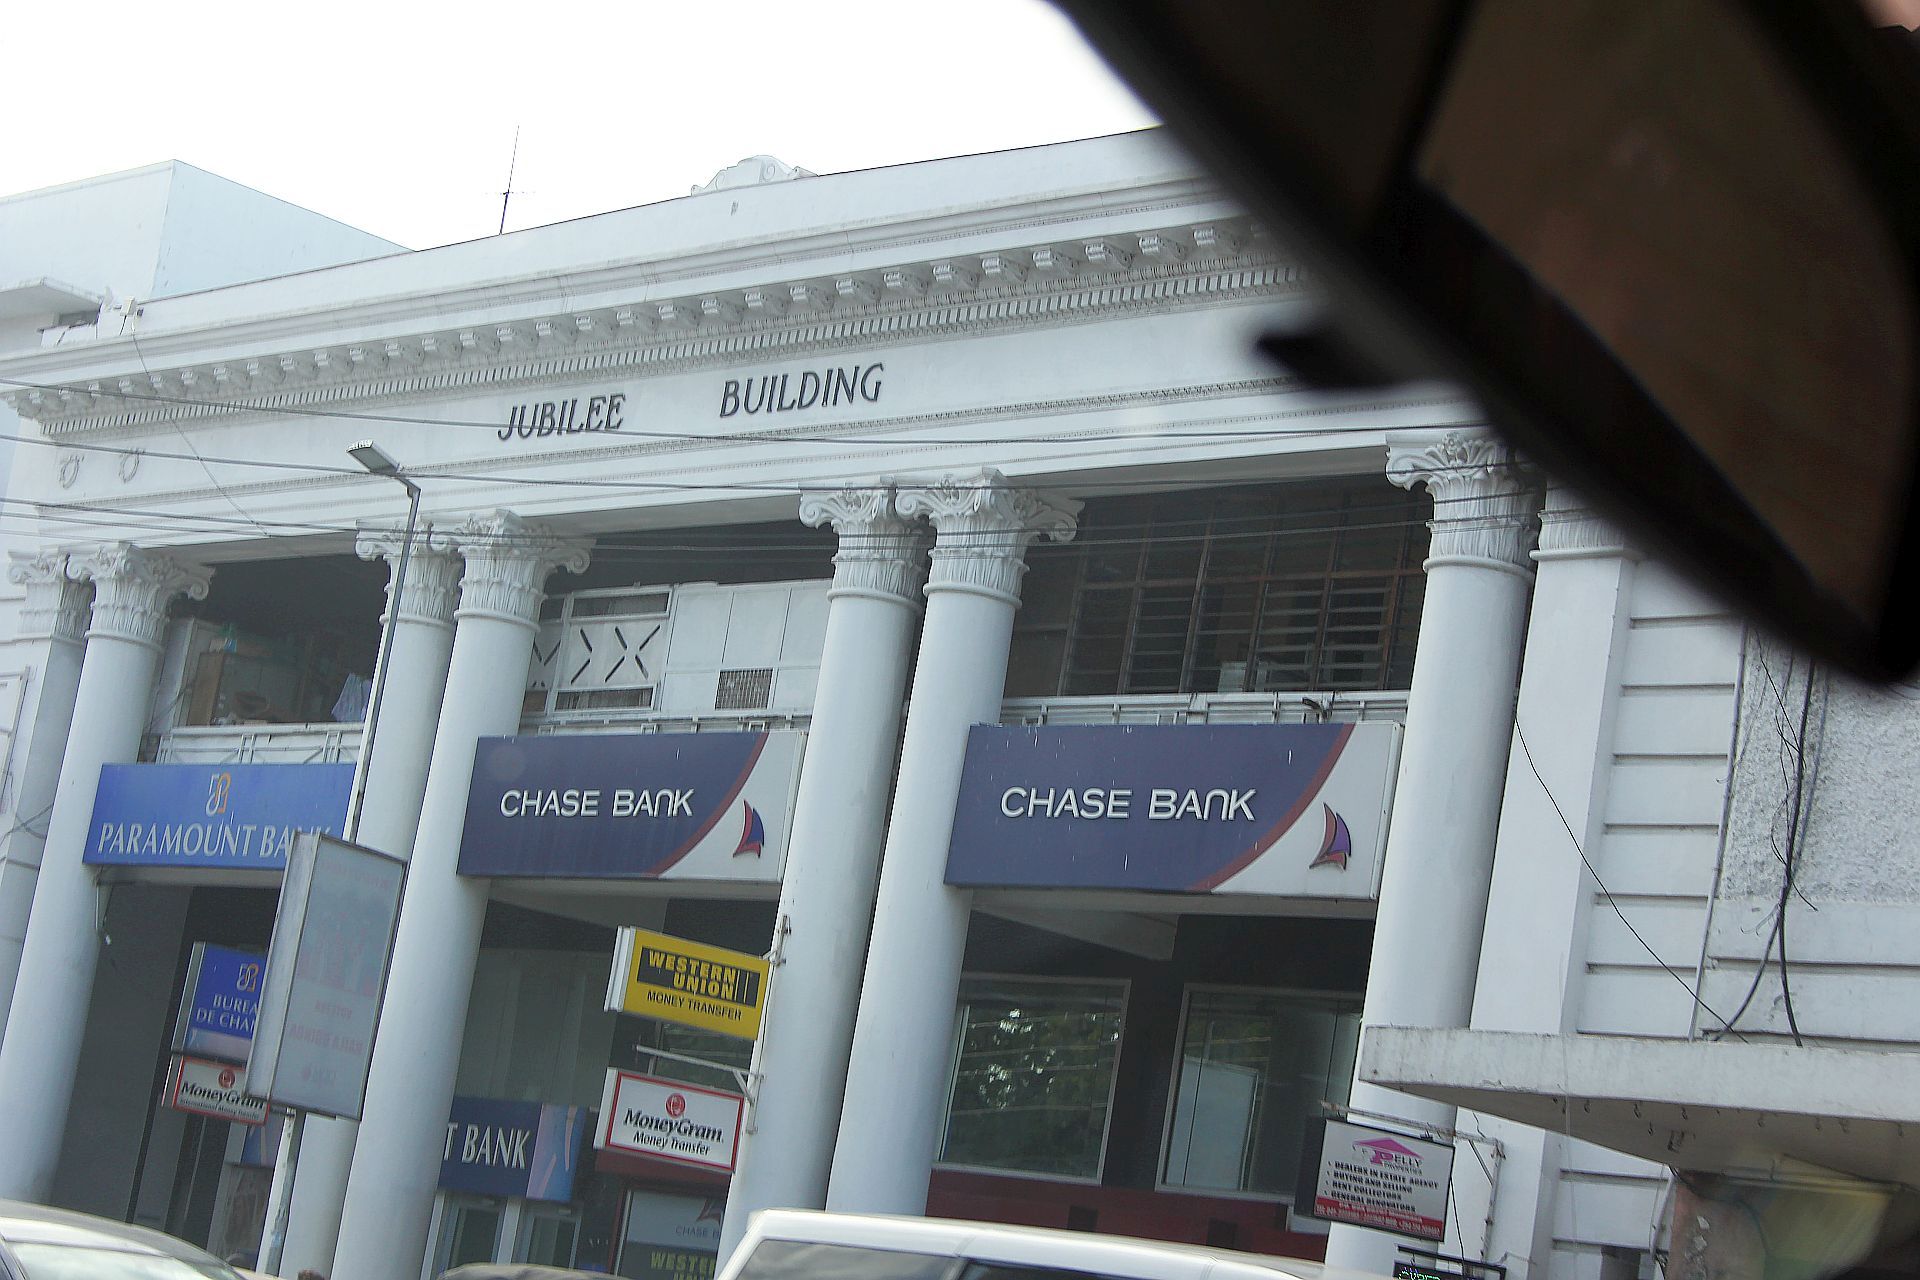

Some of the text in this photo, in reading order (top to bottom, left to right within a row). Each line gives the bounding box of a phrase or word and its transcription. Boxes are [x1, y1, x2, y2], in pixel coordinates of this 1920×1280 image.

[498, 362, 884, 440] JUBILEE BUILDING
[500, 788, 694, 817] CHASE BANK
[1001, 786, 1256, 821] CHASE BANK
[97, 822, 331, 858] PARAMOUNT BA
[649, 949, 741, 985] WESTERN
[673, 972, 734, 1000] UNION
[196, 1007, 215, 1024] DE
[647, 990, 742, 1021] MONEY TRANSFER
[624, 1107, 722, 1142] MoneyGram
[461, 1124, 531, 1169] BANK
[633, 1131, 711, 1155] Money Transfer
[1369, 1168, 1378, 1177] IN
[675, 1225, 707, 1238] CHASE
